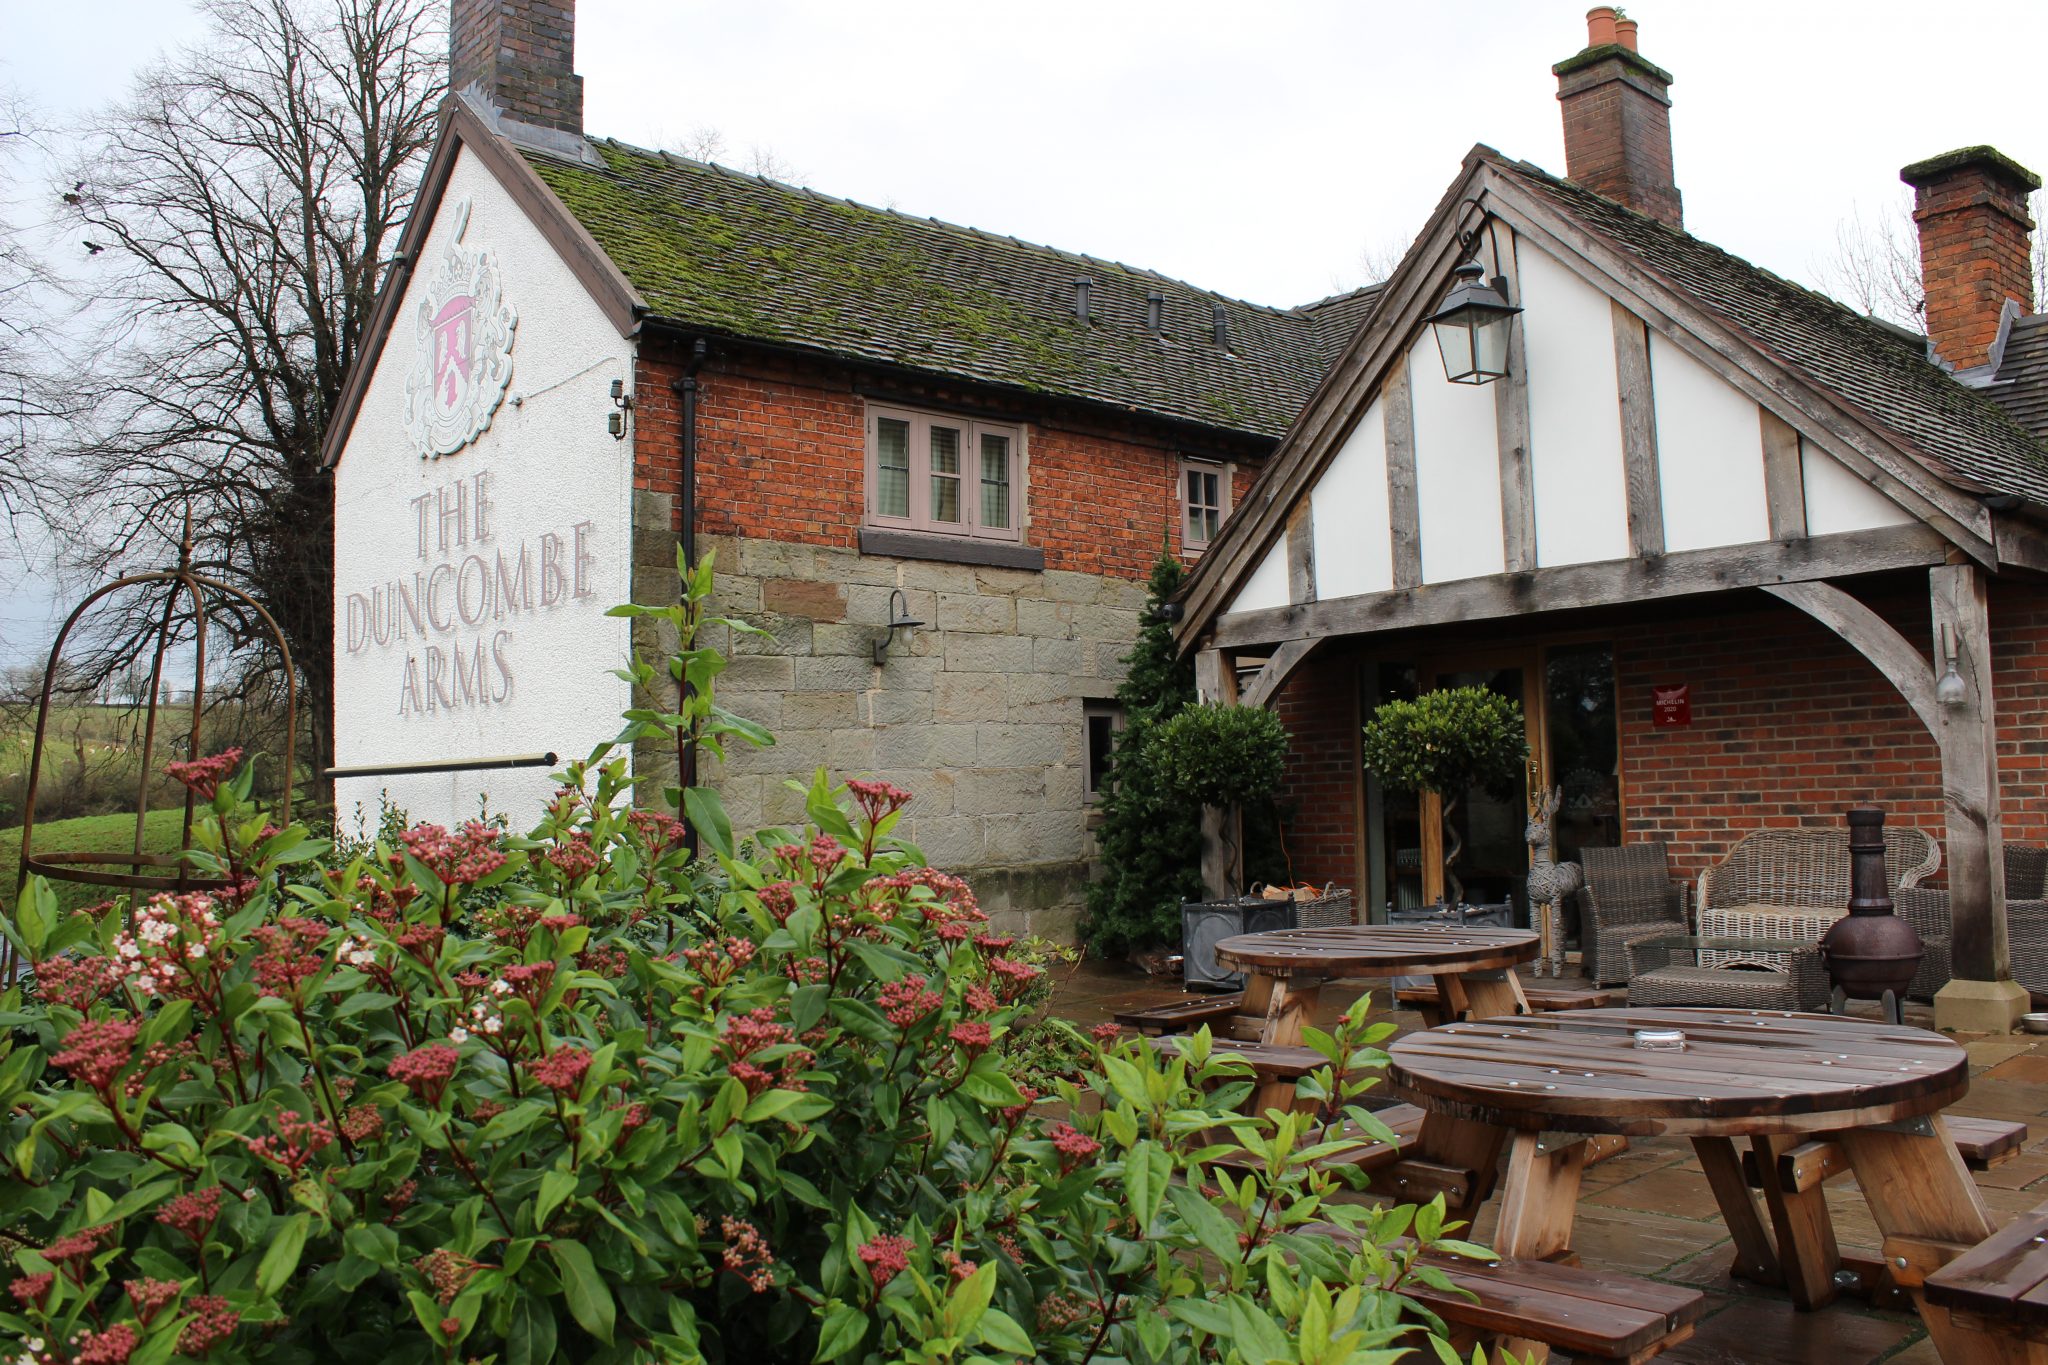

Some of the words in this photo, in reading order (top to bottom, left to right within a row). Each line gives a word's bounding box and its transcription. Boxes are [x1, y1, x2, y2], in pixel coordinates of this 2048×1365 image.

[410, 469, 491, 559] THE
[345, 519, 593, 654] DUNCOMBE
[397, 629, 511, 715] ARMS
[1656, 698, 1685, 706] MICHELIN
